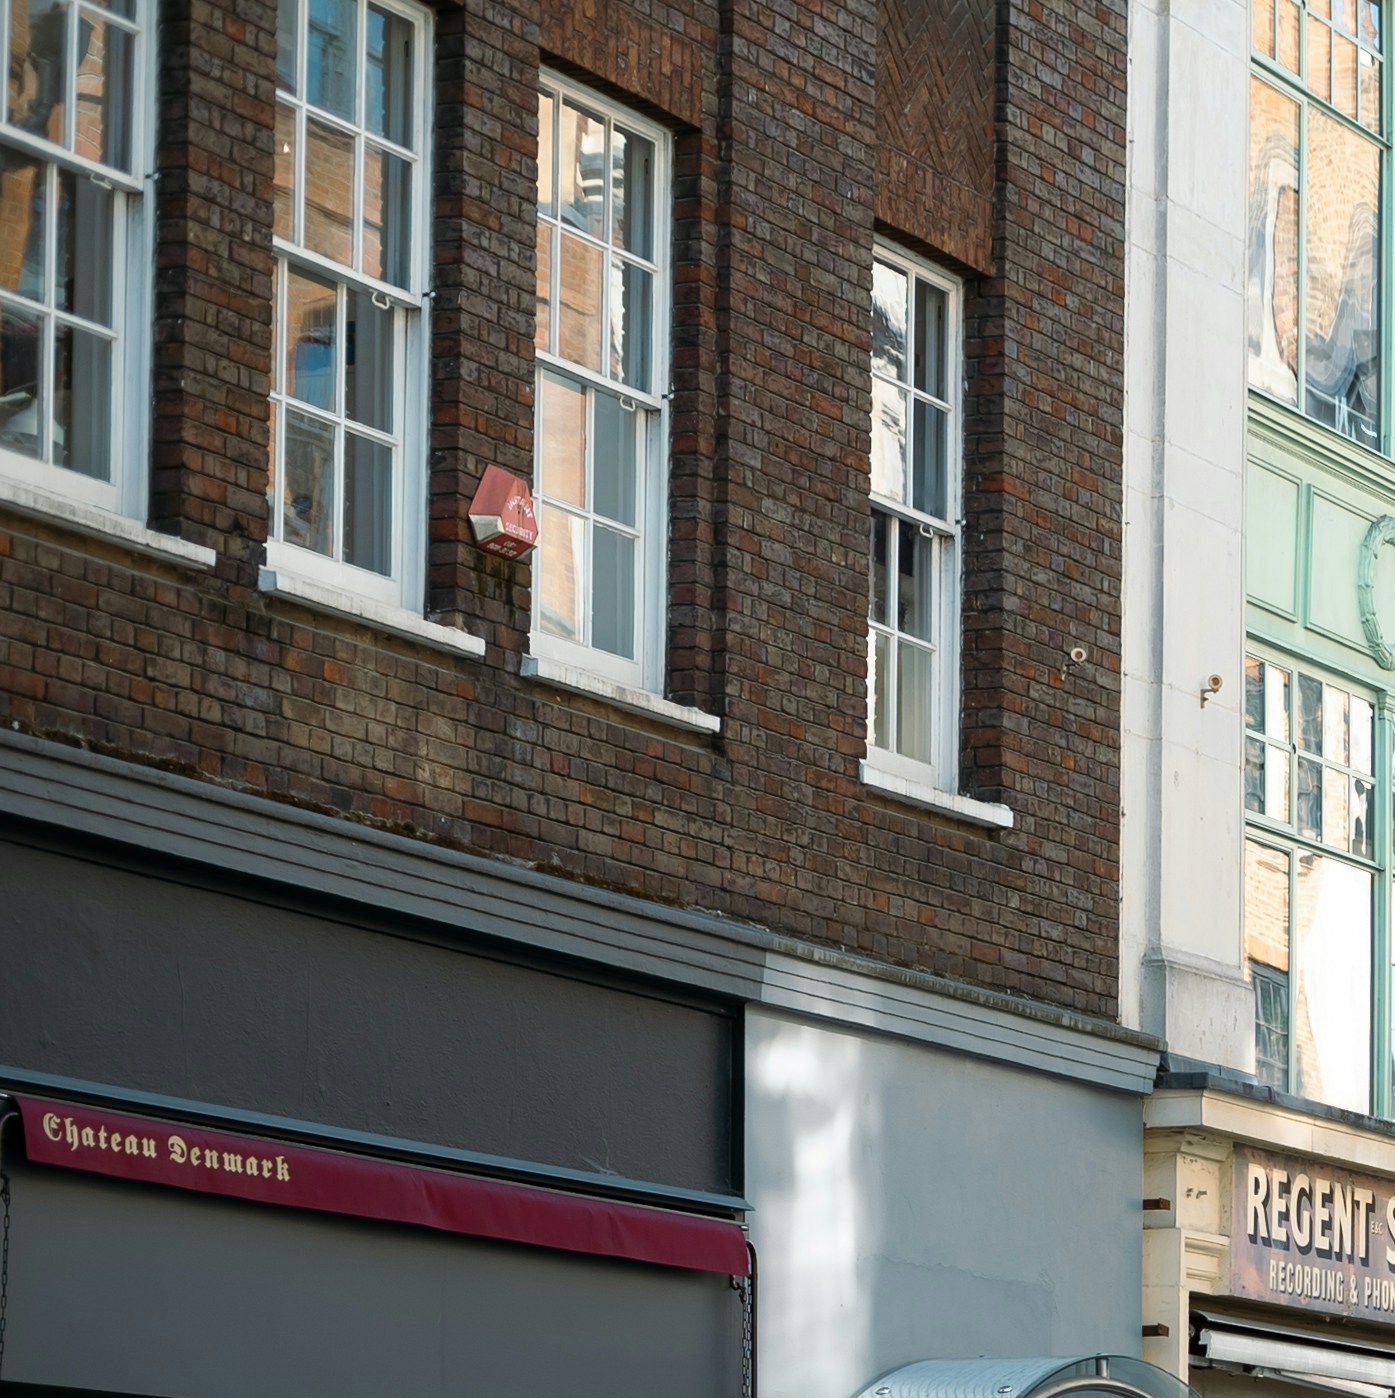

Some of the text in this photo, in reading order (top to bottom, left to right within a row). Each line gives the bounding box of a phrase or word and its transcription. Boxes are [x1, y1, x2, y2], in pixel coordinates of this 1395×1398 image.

[43, 1113, 291, 1181] Chateau Denmark
[1247, 1163, 1374, 1266] REGENT
[1269, 1259, 1344, 1304] RECORDING
[1350, 1275, 1359, 1305] &
